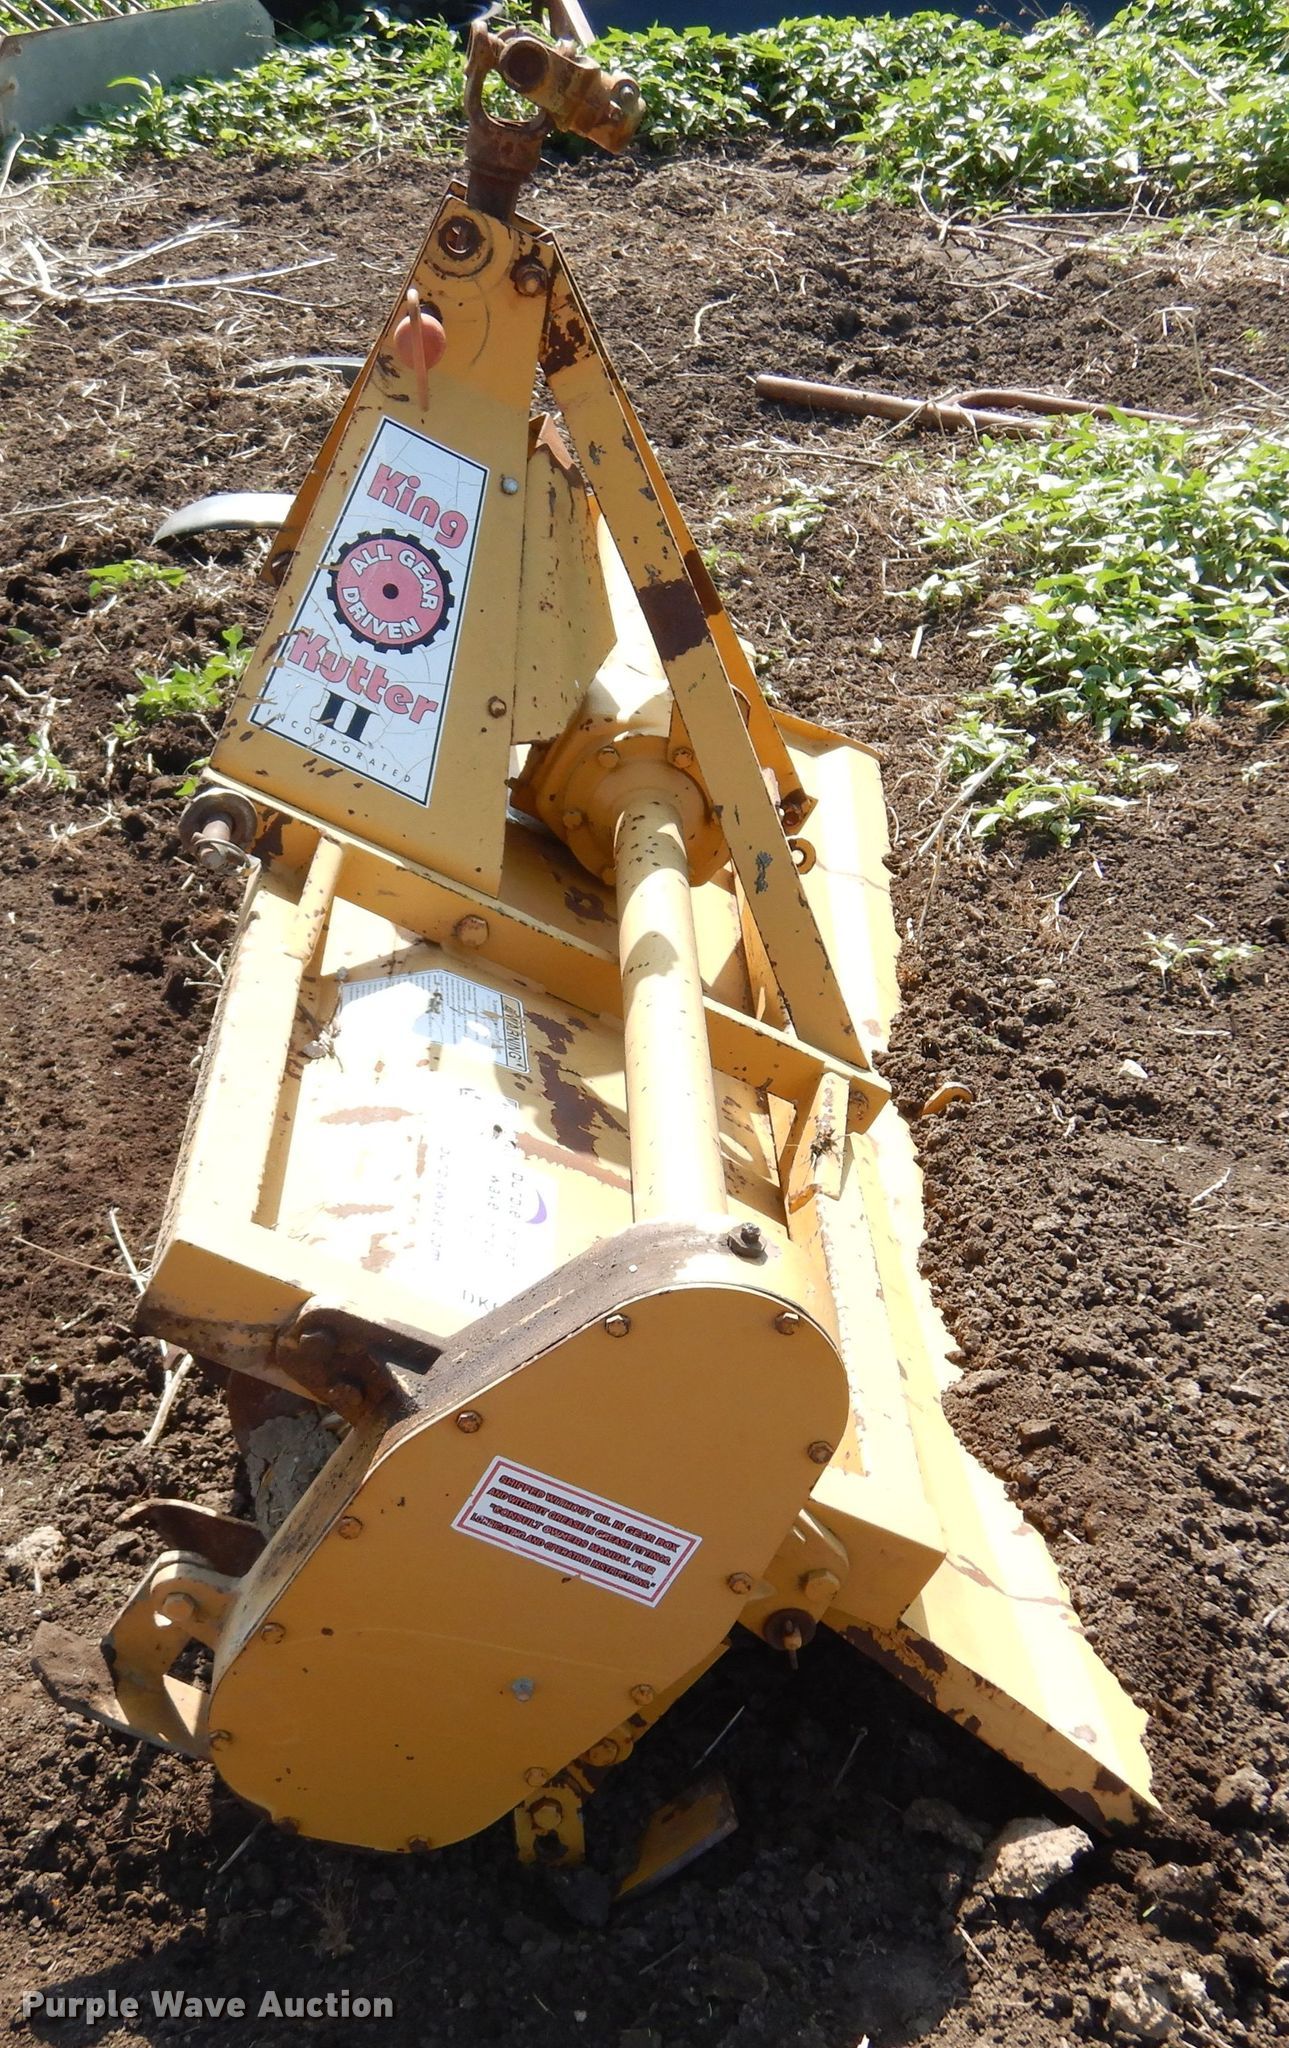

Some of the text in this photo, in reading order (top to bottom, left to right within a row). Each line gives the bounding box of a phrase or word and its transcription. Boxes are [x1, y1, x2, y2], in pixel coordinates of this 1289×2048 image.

[367, 464, 468, 549] King
[350, 544, 438, 610] ALL GEAR
[341, 586, 420, 639] DRIVEN
[287, 632, 439, 725] Kutter
[267, 709, 412, 784] INCORPORATED
[311, 688, 381, 745] II
[505, 1012, 523, 1062] WARNING
[486, 1486, 510, 1501] AND
[507, 1492, 550, 1517] WITHOUT
[547, 1509, 587, 1531] GREASE
[585, 1523, 597, 1536] IN
[594, 1528, 634, 1550] GREASE
[499, 1474, 681, 1553] SHIPPED WITHOUT OIL IN GEAR BOX
[525, 1534, 546, 1549] AND
[543, 1539, 592, 1565] OPERATING
[542, 1523, 589, 1548] OWNERS
[587, 1541, 632, 1567] MANUAL
[631, 1559, 656, 1576] FOR
